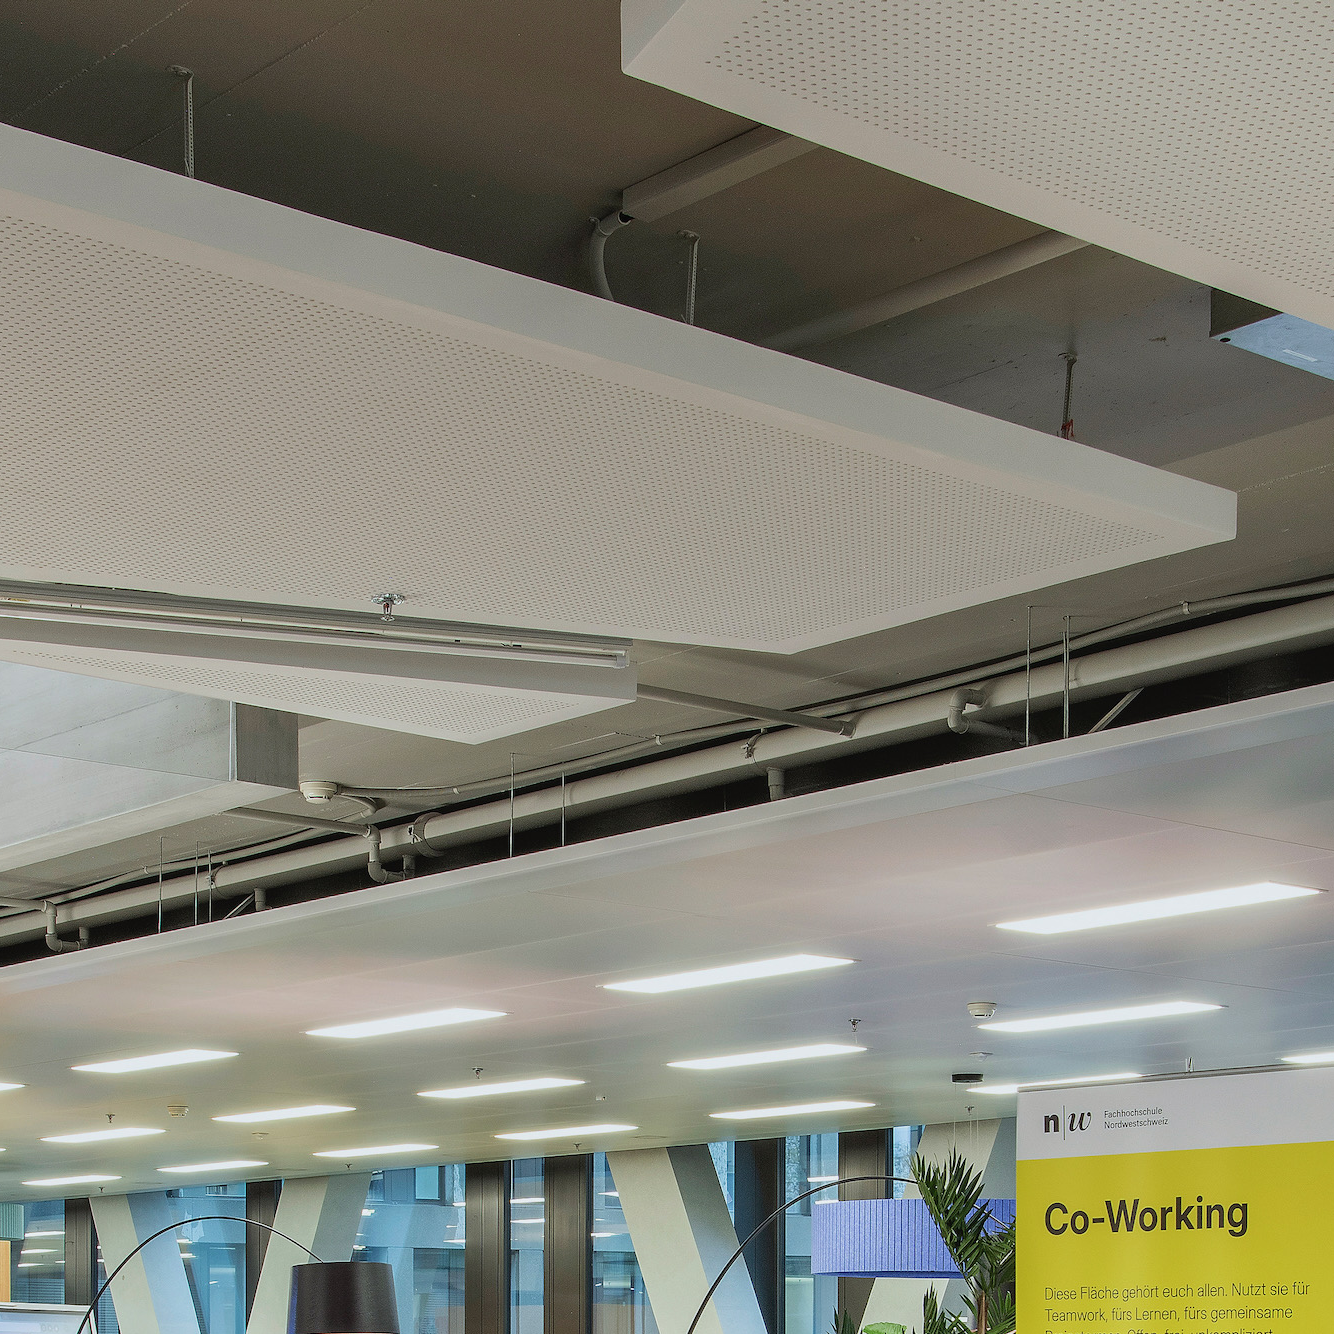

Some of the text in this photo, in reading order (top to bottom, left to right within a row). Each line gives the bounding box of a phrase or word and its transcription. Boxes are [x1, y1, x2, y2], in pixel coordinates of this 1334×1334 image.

[1104, 1107, 1163, 1119] Fachhochschule
[1104, 1117, 1169, 1129] Nordwestschweiz
[1044, 1195, 1249, 1238] Co-Working
[1044, 1281, 1310, 1302] Diese Fläche gehört euch allen. Nutzt sie für
[1045, 1305, 1293, 1323] Teamwork, fürs Lernen, fürs gemeinsame
